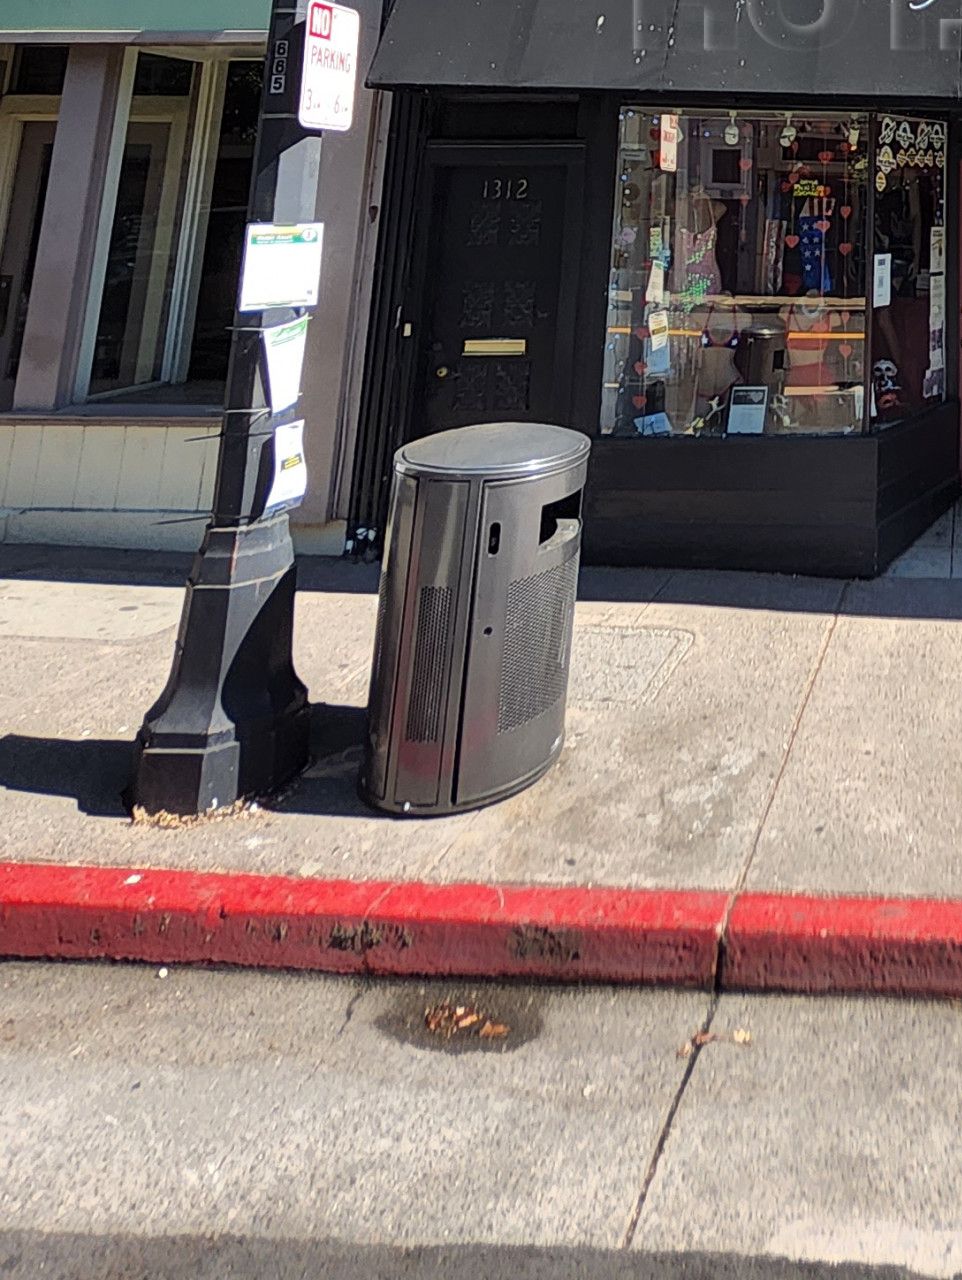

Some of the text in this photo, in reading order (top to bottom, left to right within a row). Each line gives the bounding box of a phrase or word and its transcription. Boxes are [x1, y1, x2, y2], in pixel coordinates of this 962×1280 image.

[312, 6, 330, 37] NO
[310, 45, 352, 73] PARKING
[482, 179, 528, 200] 1312
